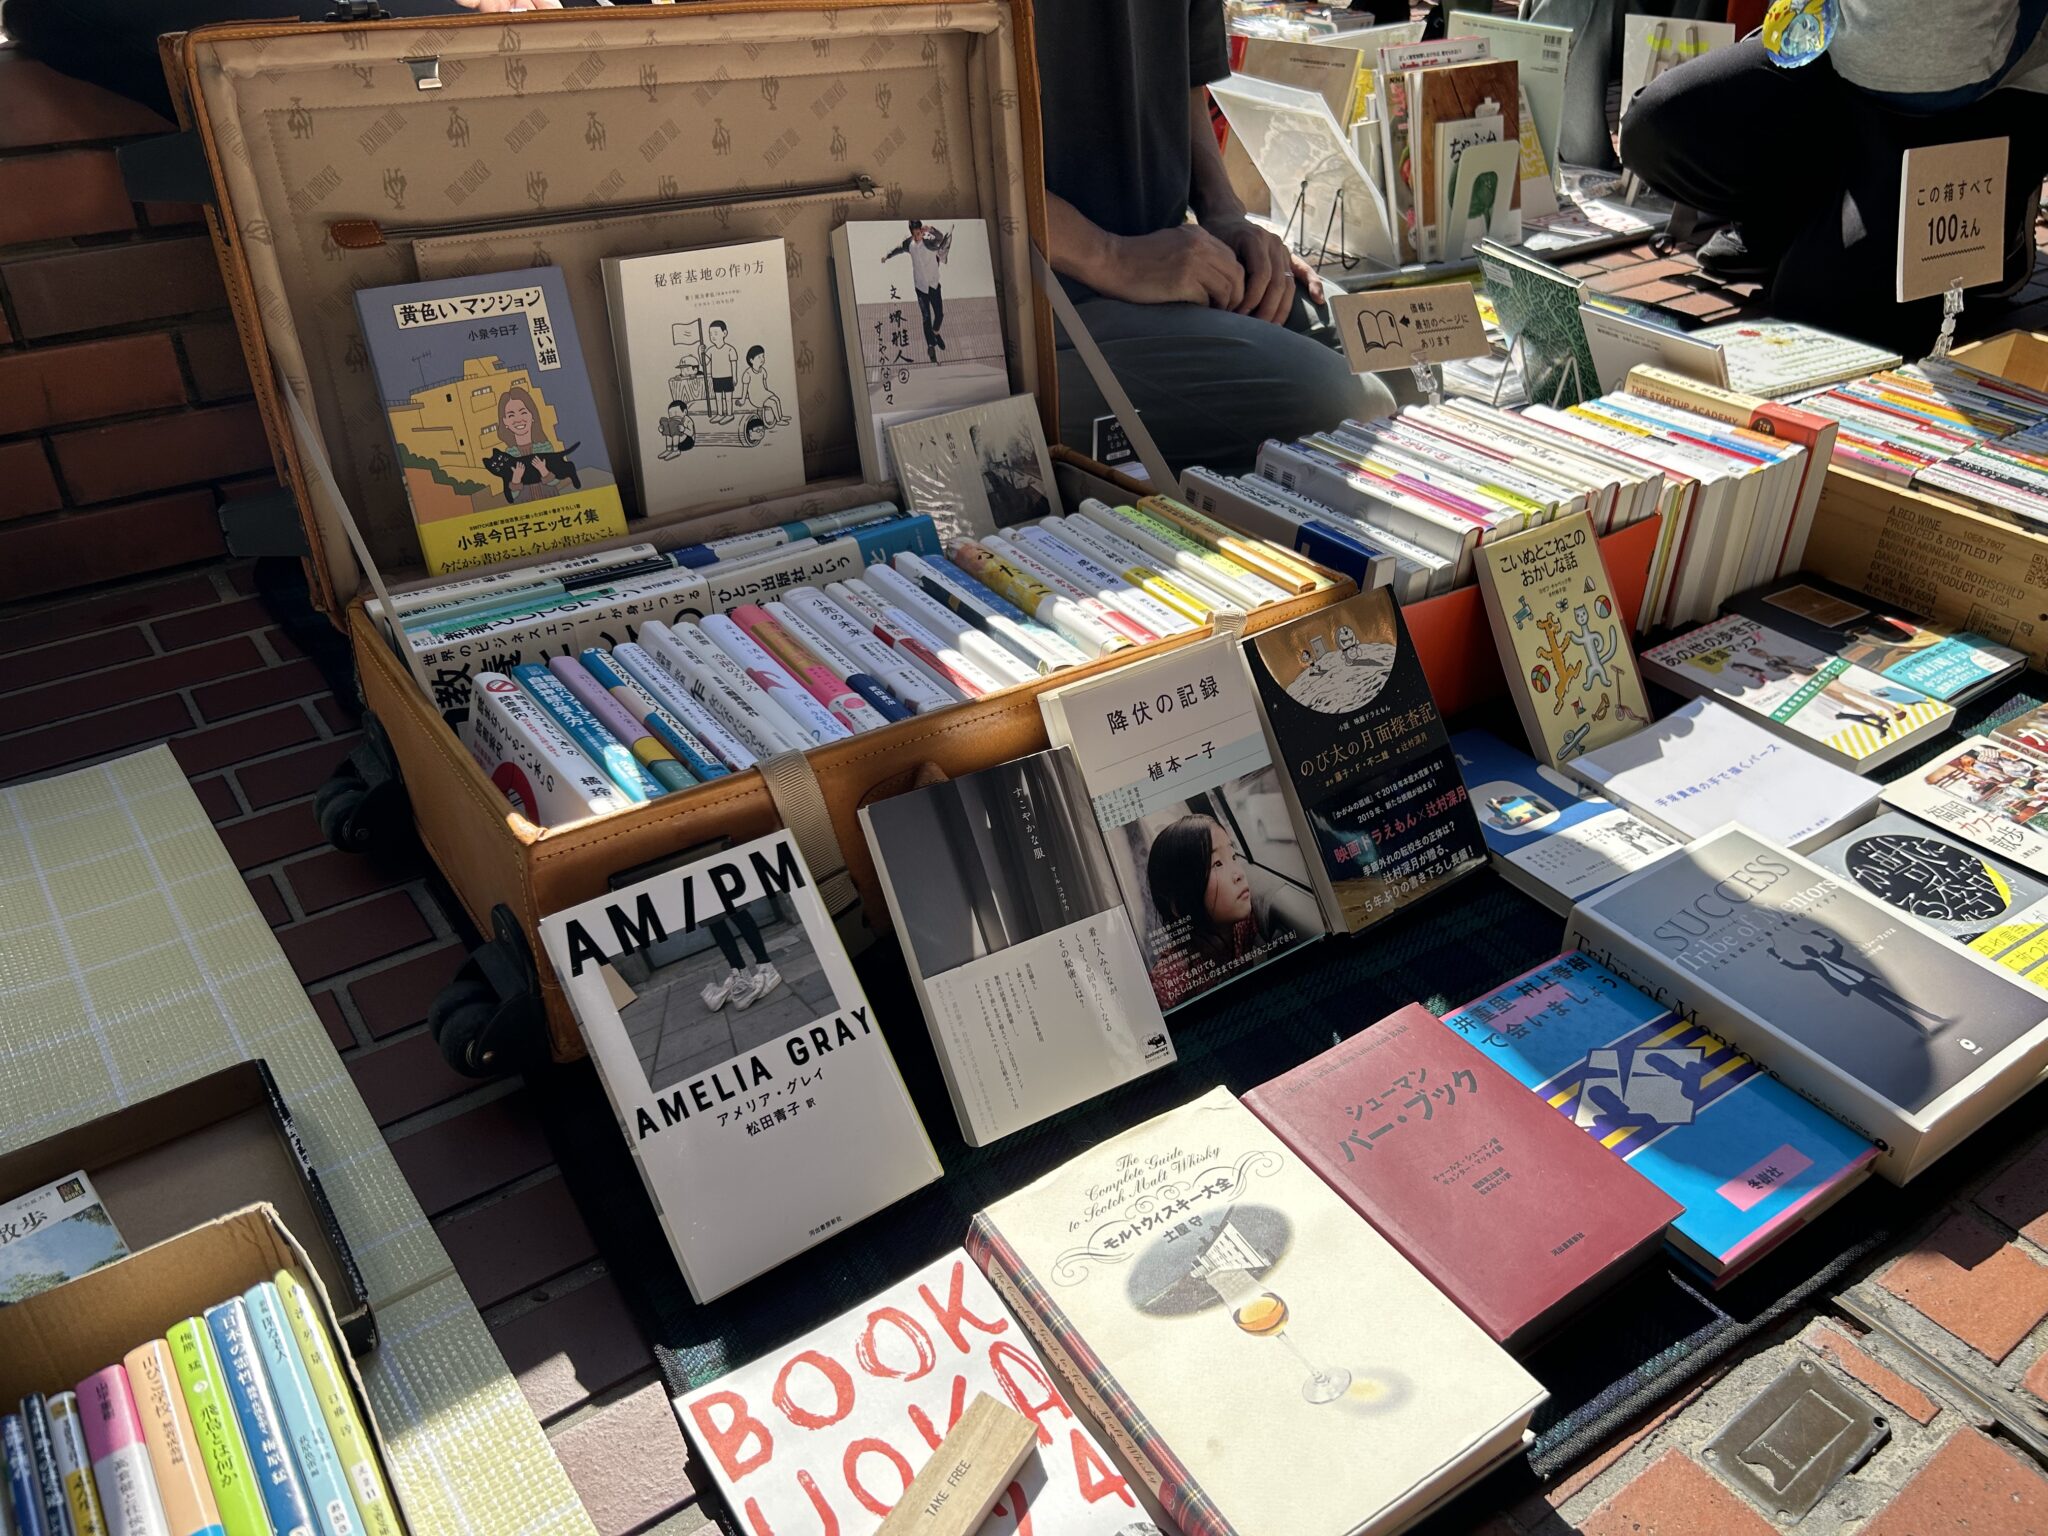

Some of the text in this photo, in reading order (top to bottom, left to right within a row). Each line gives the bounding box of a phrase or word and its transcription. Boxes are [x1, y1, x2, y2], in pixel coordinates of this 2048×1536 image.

[1916, 176, 1994, 207] この箱すべて
[1927, 213, 1981, 247] 100えん
[654, 259, 764, 288] 秘密基地の作り方
[399, 289, 542, 326] 黄色いマンション
[468, 324, 520, 341] 小泉今日子
[1409, 301, 1433, 313] 価格は
[1414, 313, 1470, 331] 最初のページに
[532, 316, 558, 366] 黒い猫
[874, 321, 894, 405] すこやかな日々
[1420, 335, 1452, 350] あります
[1651, 391, 1693, 411] STARTUP
[1693, 403, 1740, 426] ACADEMY
[457, 508, 600, 551] 小泉今日子エッセイ集
[1886, 516, 2003, 565] PRODUCED & BOTTLED BY
[1899, 509, 1916, 522] RED
[1918, 514, 1942, 531] WINE
[440, 526, 621, 575] 今だから書けること、今しか書けないこと。
[1499, 528, 1586, 573] こいぬとこねこの
[1521, 552, 1579, 587] おかしな話
[1919, 543, 1960, 563] MONDAVI
[1932, 571, 1975, 594] PRODUCT
[1976, 587, 1989, 600] OF
[1990, 594, 2010, 608] USA
[1951, 564, 1963, 576] DE
[1964, 571, 2025, 600] ROTHSCHILD
[423, 590, 700, 667] 世界のビジネスエリートが身につける
[444, 588, 641, 641] 教養としてのワイン
[812, 599, 866, 638] 小売の未来
[1659, 621, 1763, 667] あの世の歩き方
[1107, 675, 1220, 735] 降伏の記録
[1147, 741, 1217, 783] 植本一子
[1300, 700, 1438, 778] のび太の月面探査記
[1012, 786, 1046, 861] すこやかな服
[1333, 784, 1468, 864] 映画ドラえもん×辻村深月
[1362, 822, 1456, 877] 季節外れの転校生の正体は?
[1364, 845, 1475, 913] 5年ぶりの書き下ろし長編!
[1383, 847, 1451, 886] 辻村深月が贈る、
[564, 840, 808, 977] AM/PM
[1652, 853, 1790, 951] SUCCESS
[1672, 934, 1739, 973] Tribe
[1737, 916, 1763, 941] of
[1759, 878, 1840, 932] Mentors
[1058, 939, 1087, 1010] その秘密とは?
[1074, 931, 1112, 1033] くるくる回りたくなる
[1087, 925, 1119, 998] 着た人みんなが
[1515, 953, 1593, 1000] 村上春樹
[1480, 974, 1619, 1048] で会いましょう
[633, 1055, 773, 1140] AMELIA
[785, 1005, 874, 1067] GRAY
[716, 1067, 825, 1127] アメリア・グレイ
[1345, 1067, 1429, 1121] シューマン
[745, 1100, 801, 1137] 松田青子
[1338, 1069, 1479, 1163] バー・ブック
[1068, 1144, 1221, 1233] to Scotch Malt Whisky
[1084, 1146, 1185, 1202] Complete Guide
[1116, 1152, 1141, 1174] The
[1103, 1176, 1235, 1253] モルトウィスキー大全
[688, 1260, 1009, 1483] BOOK
[1005, 1284, 1039, 1330] Complete
[1035, 1324, 1061, 1355] Guide
[1067, 1360, 1099, 1402] Scotch
[1098, 1404, 1124, 1437] Malt
[1122, 1434, 1161, 1485] Whisky
[200, 1403, 238, 1488] 飛鳥とは何か
[924, 1459, 972, 1518] TAKE FREE
